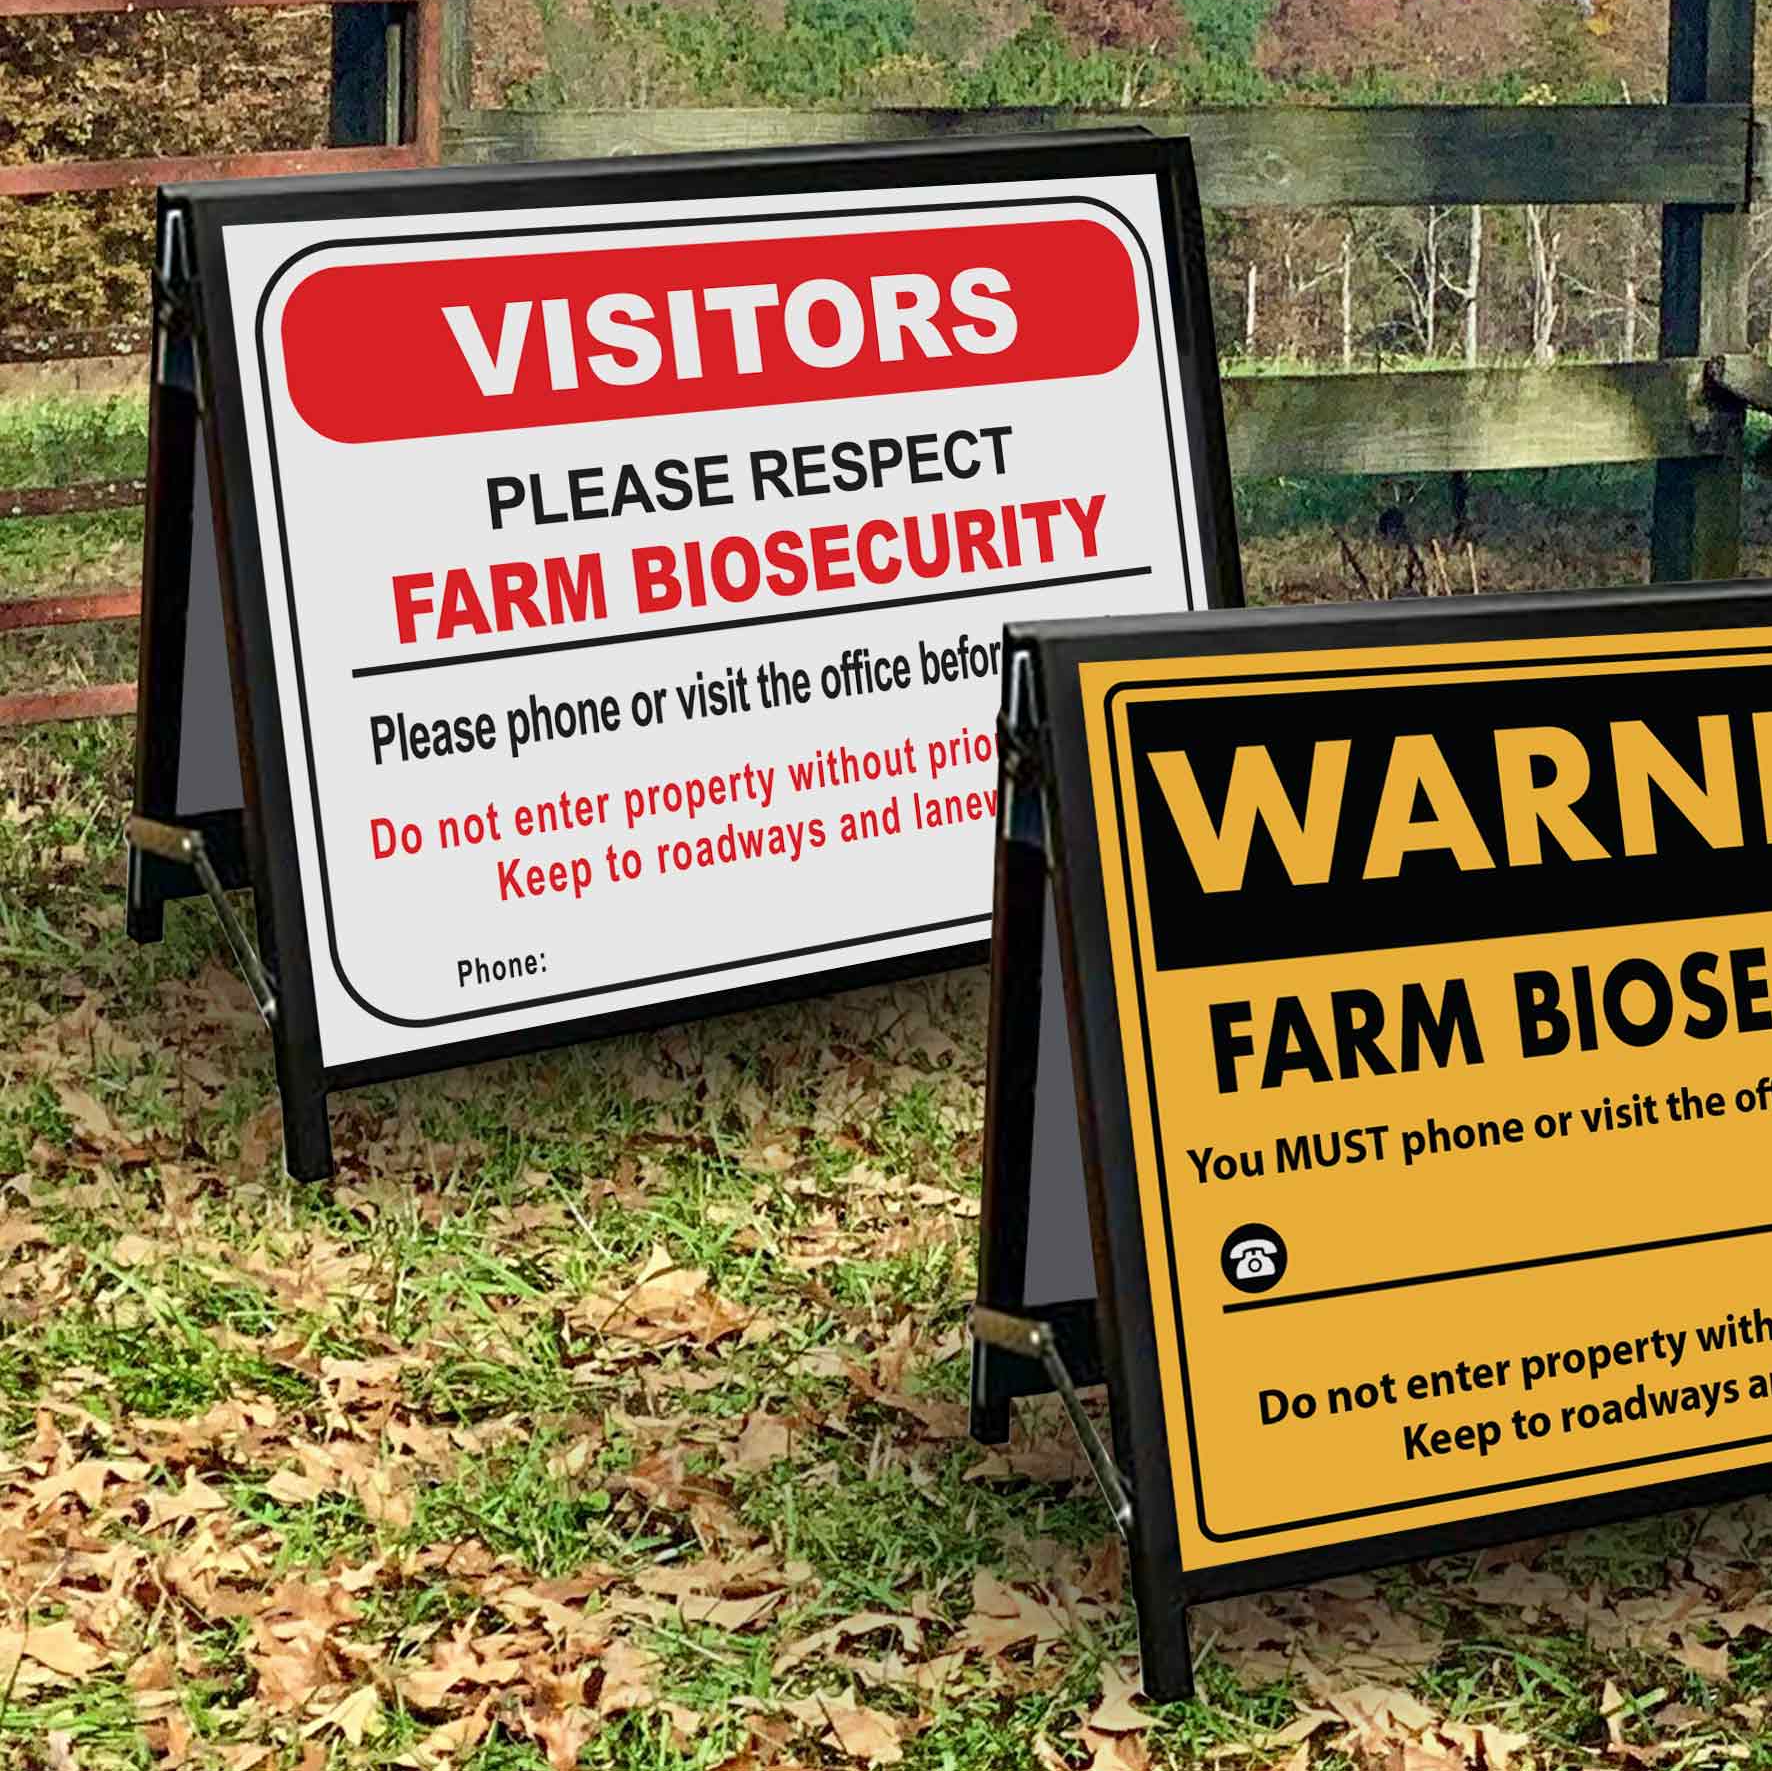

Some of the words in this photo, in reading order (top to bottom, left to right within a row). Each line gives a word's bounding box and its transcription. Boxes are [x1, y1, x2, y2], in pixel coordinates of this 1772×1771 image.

[442, 268, 1017, 396] VISITORS
[487, 455, 733, 529] PLEASE
[750, 426, 1012, 500] RESPECT
[392, 553, 607, 644] FARM
[632, 494, 1106, 613] BIOSECURITY
[371, 713, 496, 765] Please
[507, 695, 620, 757] phone
[632, 689, 666, 726] or
[676, 668, 750, 719] visit
[757, 662, 810, 708] the
[821, 649, 910, 699] office
[371, 818, 422, 859] Do
[439, 803, 501, 848] not
[515, 791, 608, 836] enter
[625, 764, 774, 828] property
[788, 738, 916, 791] without
[498, 858, 591, 900] Keep
[606, 845, 641, 882] to
[658, 819, 825, 873] roadways
[840, 797, 900, 842] and
[458, 953, 546, 987] Phone:
[1209, 979, 1484, 1093] FARM
[1187, 1148, 1264, 1183] You
[1276, 1125, 1388, 1173] MUST
[1402, 1119, 1523, 1165] phone
[1535, 1112, 1572, 1138] or
[1581, 1094, 1659, 1132] visit
[1666, 1087, 1725, 1121] the
[1259, 1390, 1316, 1425] Do
[1328, 1374, 1397, 1413] not
[1407, 1360, 1510, 1399] enter
[1522, 1330, 1686, 1390] property
[1404, 1421, 1501, 1460] Keep
[1512, 1411, 1550, 1440] to
[1562, 1380, 1739, 1432] roadways
